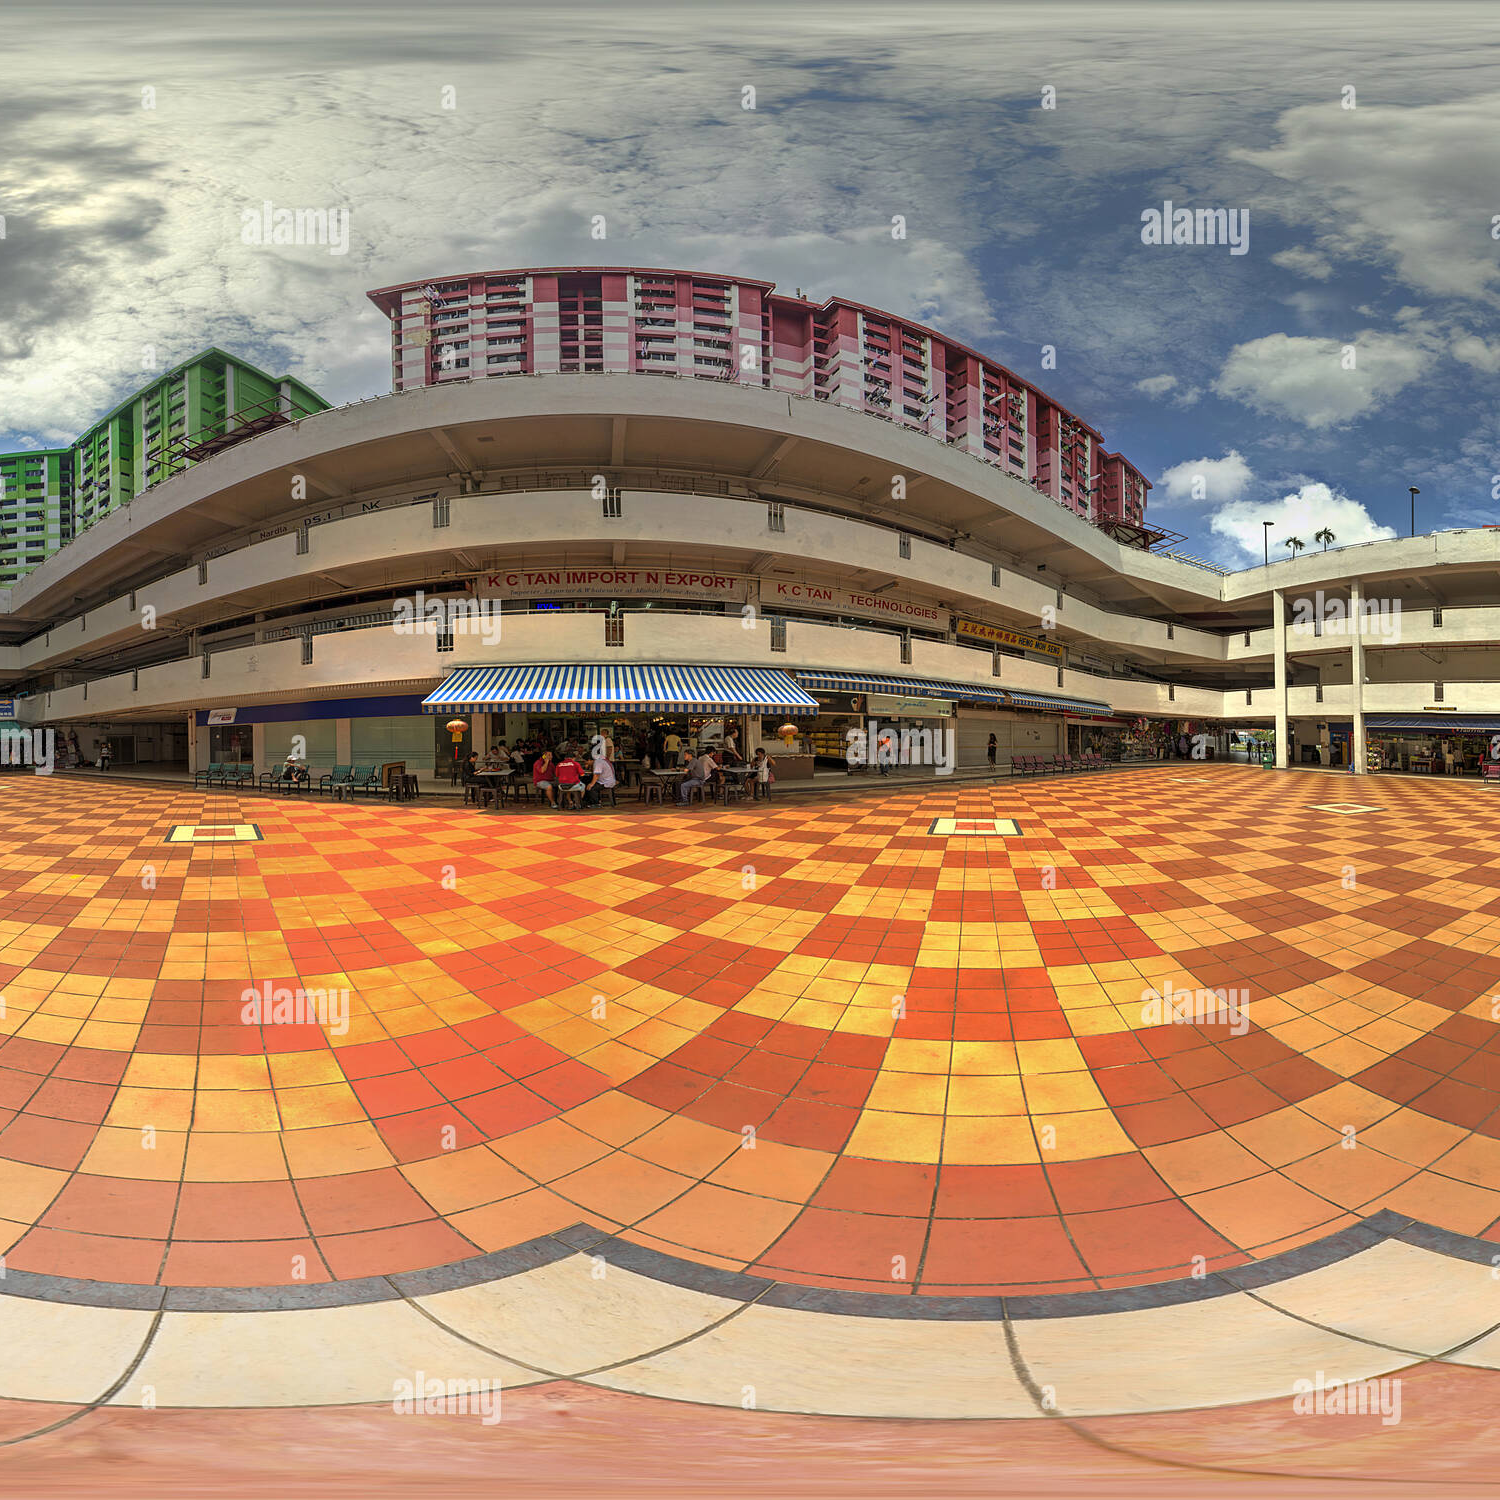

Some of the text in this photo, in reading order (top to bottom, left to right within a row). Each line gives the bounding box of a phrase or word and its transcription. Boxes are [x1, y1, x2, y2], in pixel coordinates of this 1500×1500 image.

[488, 571, 738, 589] K C TAN IMPORT N EXPORT
[777, 583, 832, 600] K C TAN
[850, 594, 938, 620] TECHNOLOGIES
